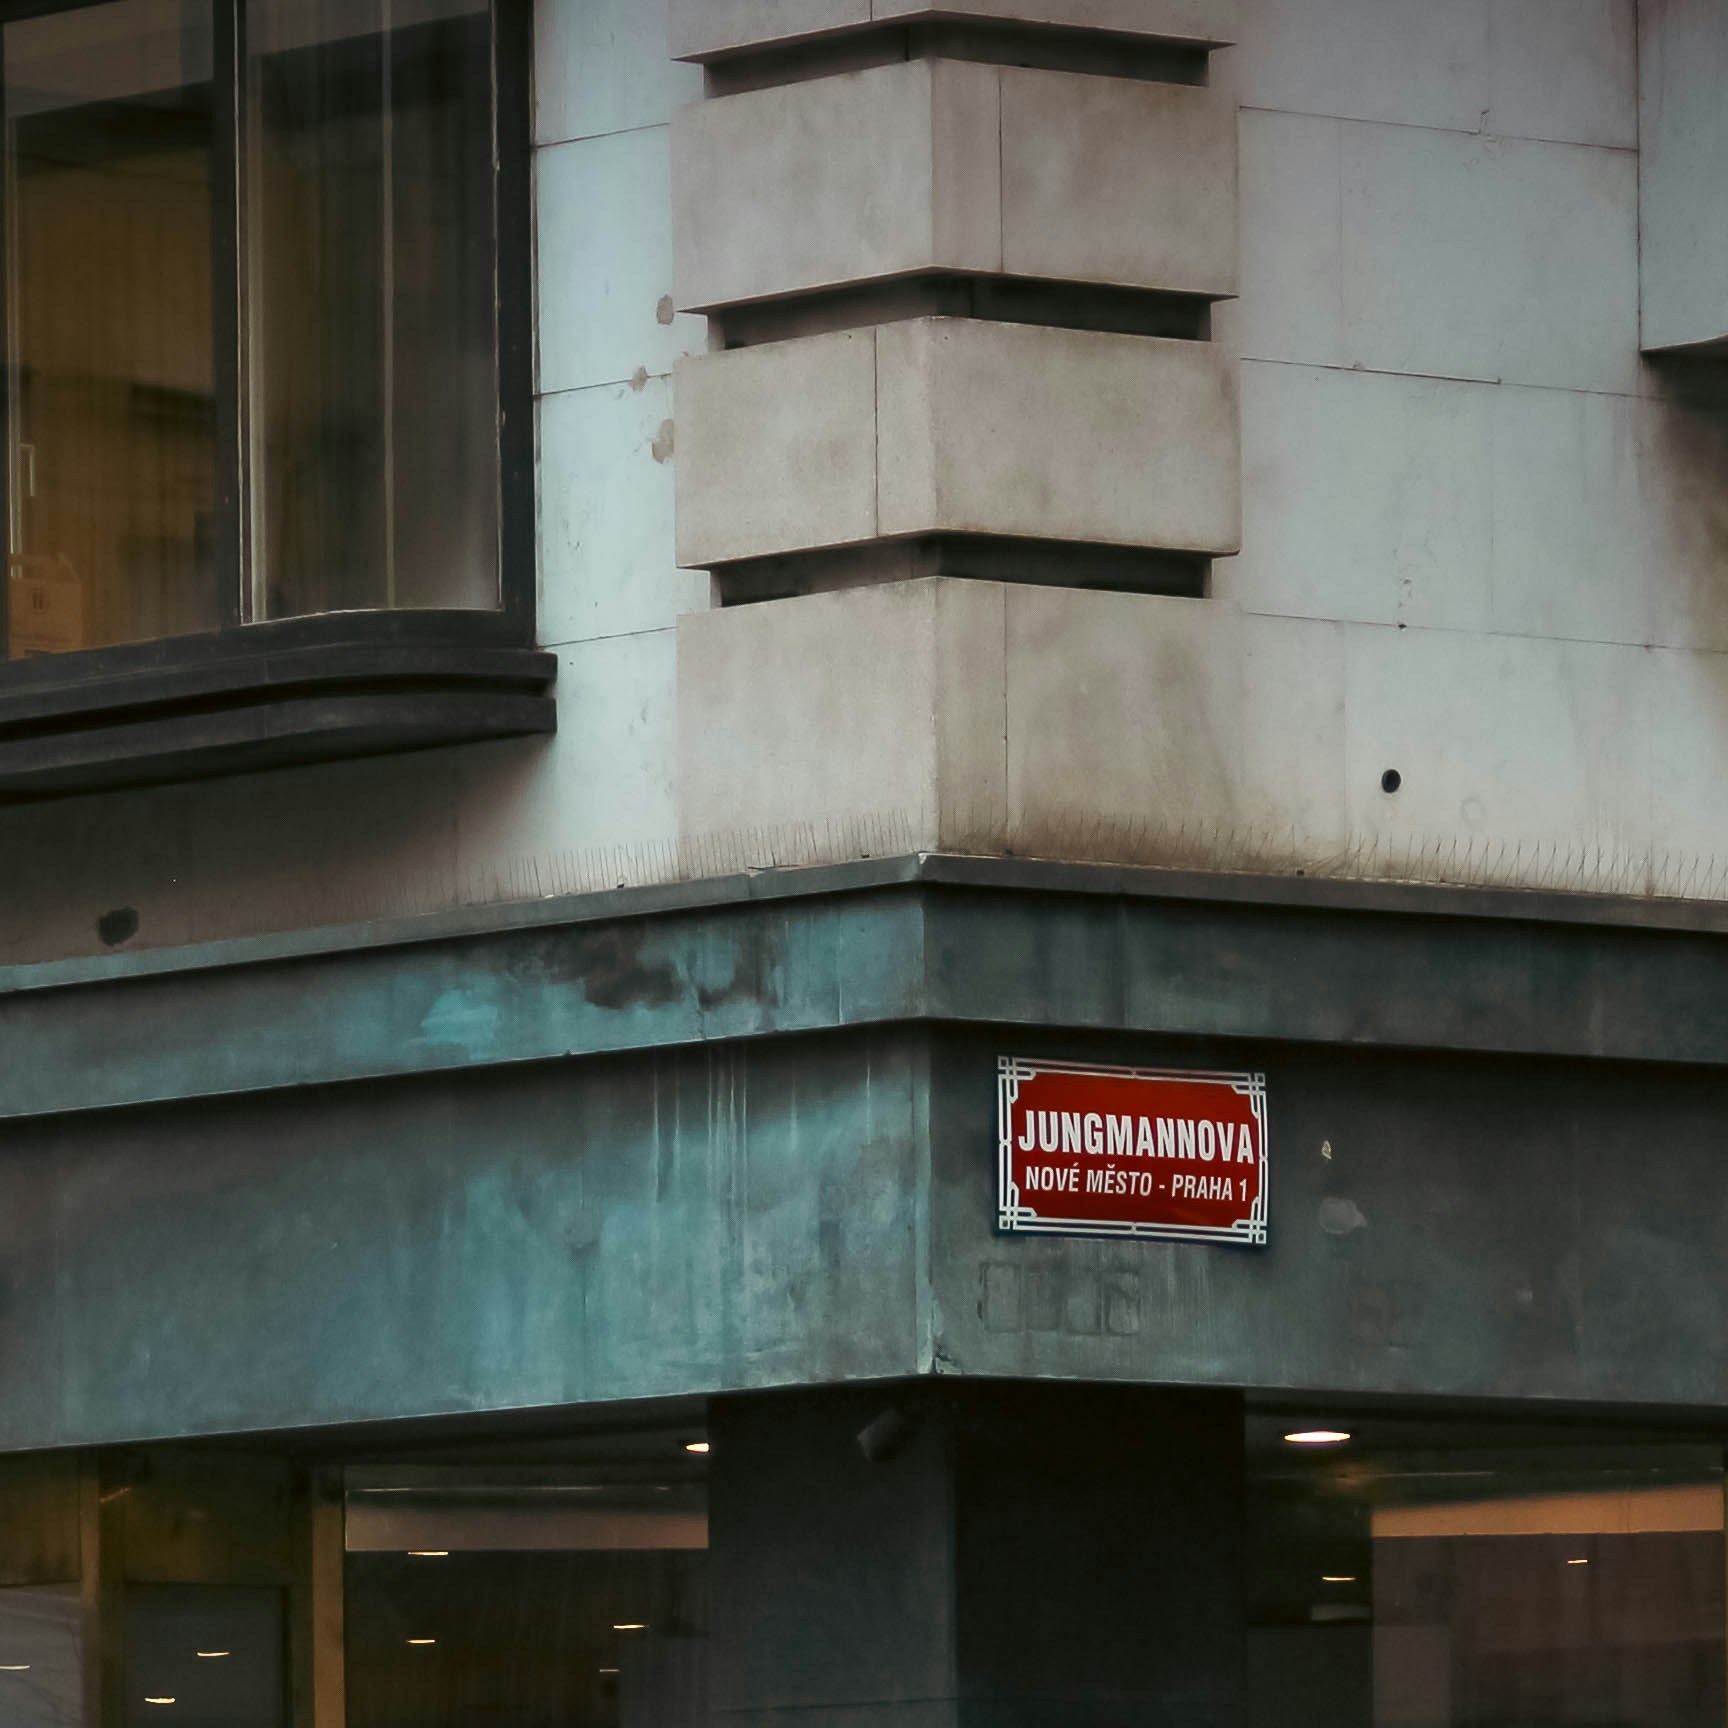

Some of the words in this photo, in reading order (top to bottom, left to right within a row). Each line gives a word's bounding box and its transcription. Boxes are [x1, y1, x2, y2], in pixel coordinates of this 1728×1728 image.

[1018, 1109, 1255, 1164] JUNGMANNOVA
[1025, 1162, 1080, 1193] NOVÉ
[1086, 1163, 1153, 1197] MĚSTO
[1171, 1174, 1233, 1201] PRAHA
[1238, 1178, 1248, 1202] 1
